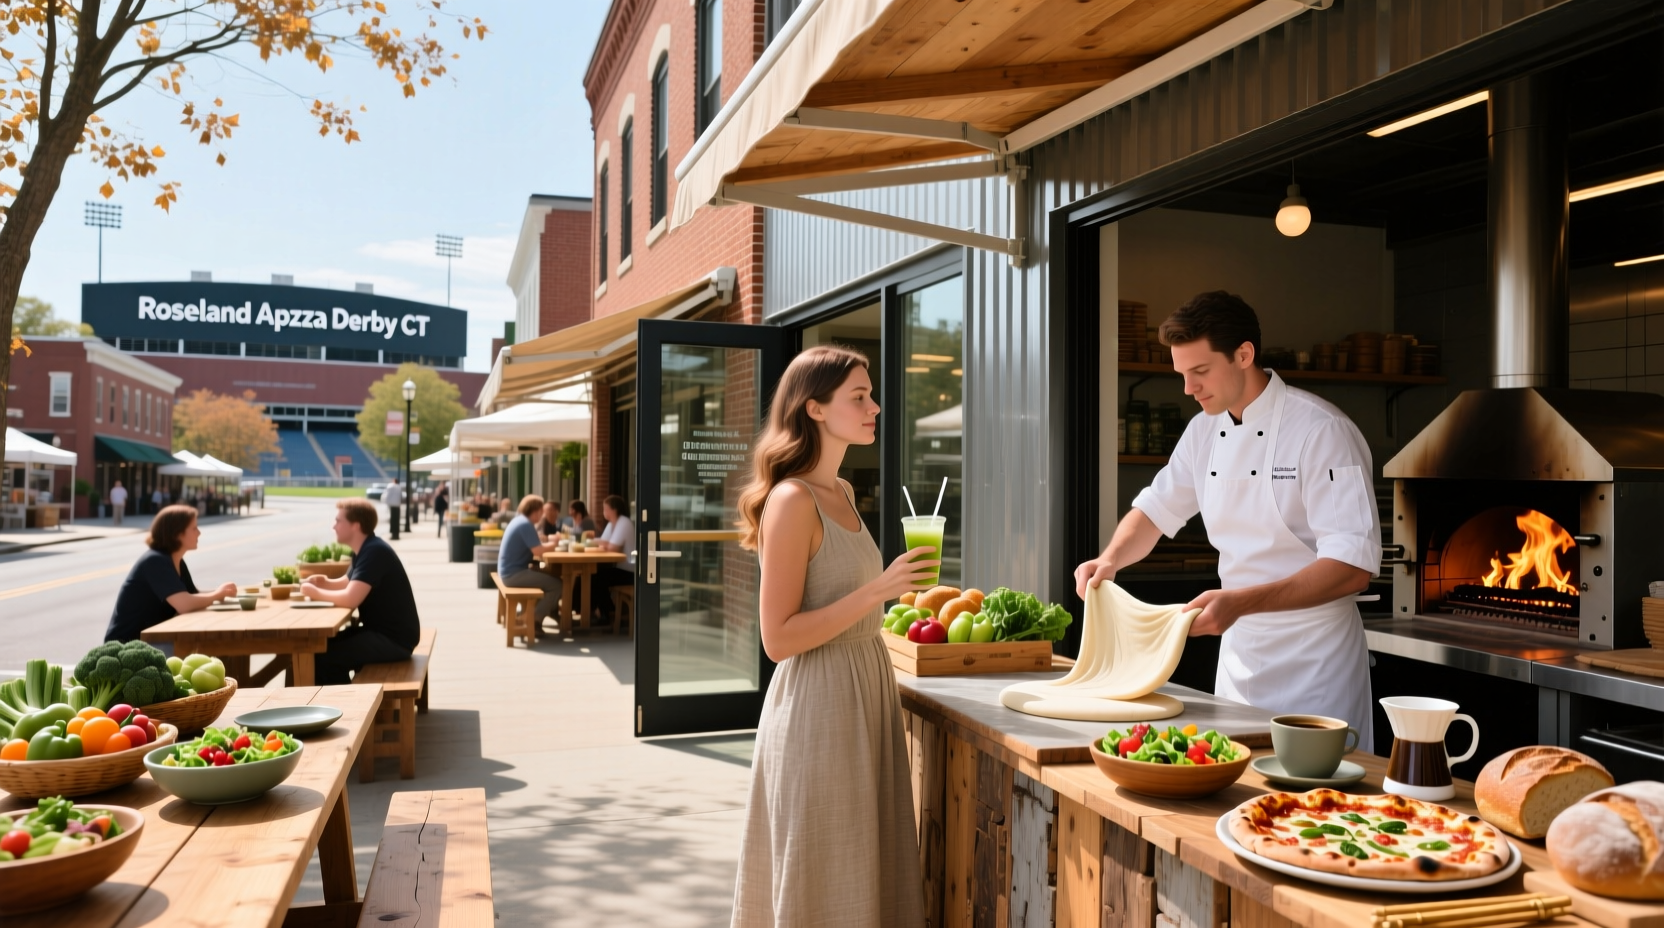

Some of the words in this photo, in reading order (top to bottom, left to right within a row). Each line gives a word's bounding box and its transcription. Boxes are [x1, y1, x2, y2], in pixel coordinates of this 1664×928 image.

[138, 296, 251, 324] Roseland
[255, 302, 328, 332] Apzza
[332, 307, 398, 340] Derby
[401, 314, 430, 337] CT
